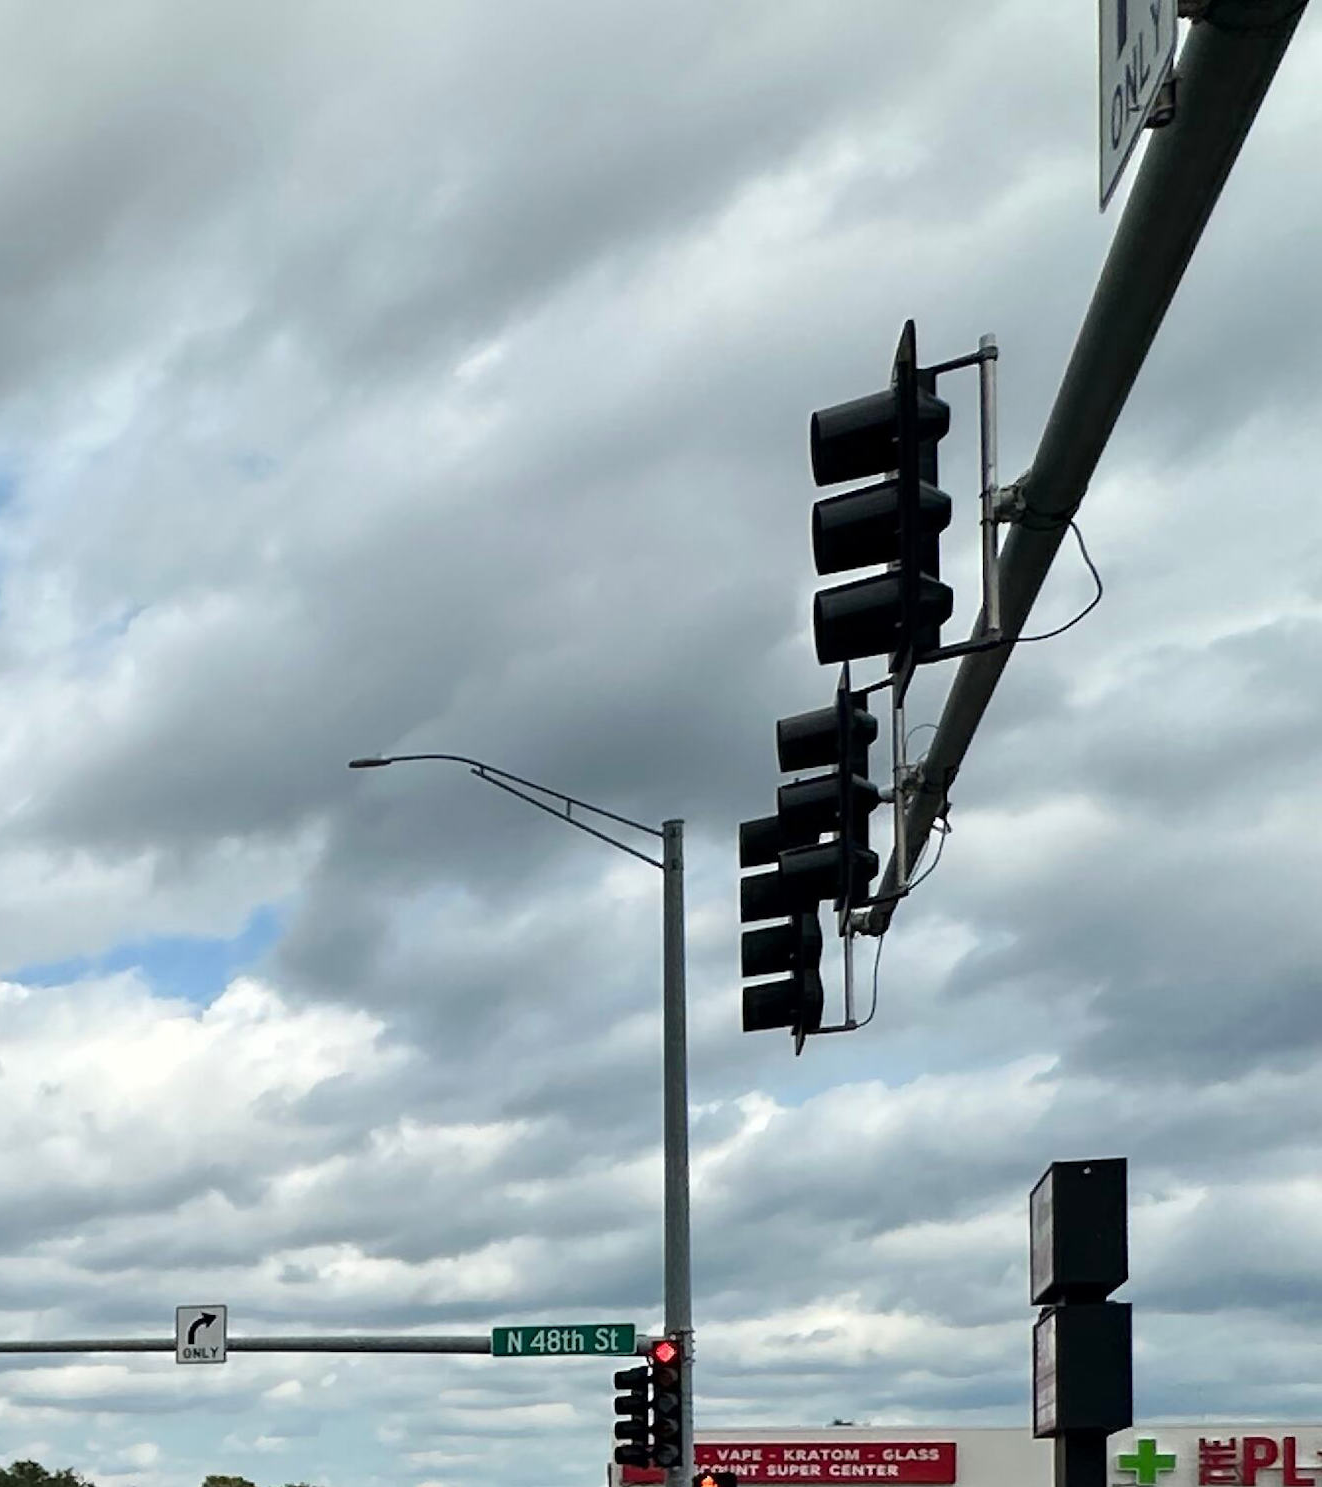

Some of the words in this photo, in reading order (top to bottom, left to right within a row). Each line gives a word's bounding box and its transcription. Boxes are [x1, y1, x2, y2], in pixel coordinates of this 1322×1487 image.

[1111, 0, 1161, 150] ONLY
[507, 1330, 523, 1353] N
[529, 1329, 585, 1353] 48th
[594, 1327, 619, 1352] St
[182, 1346, 219, 1359] ONLY
[717, 1449, 763, 1461] VAPE
[783, 1449, 860, 1462] KRATOM
[882, 1449, 940, 1461] GLASS
[1199, 1438, 1236, 1486] THE
[766, 1464, 821, 1476] SUPER
[828, 1464, 899, 1476] CENTER
